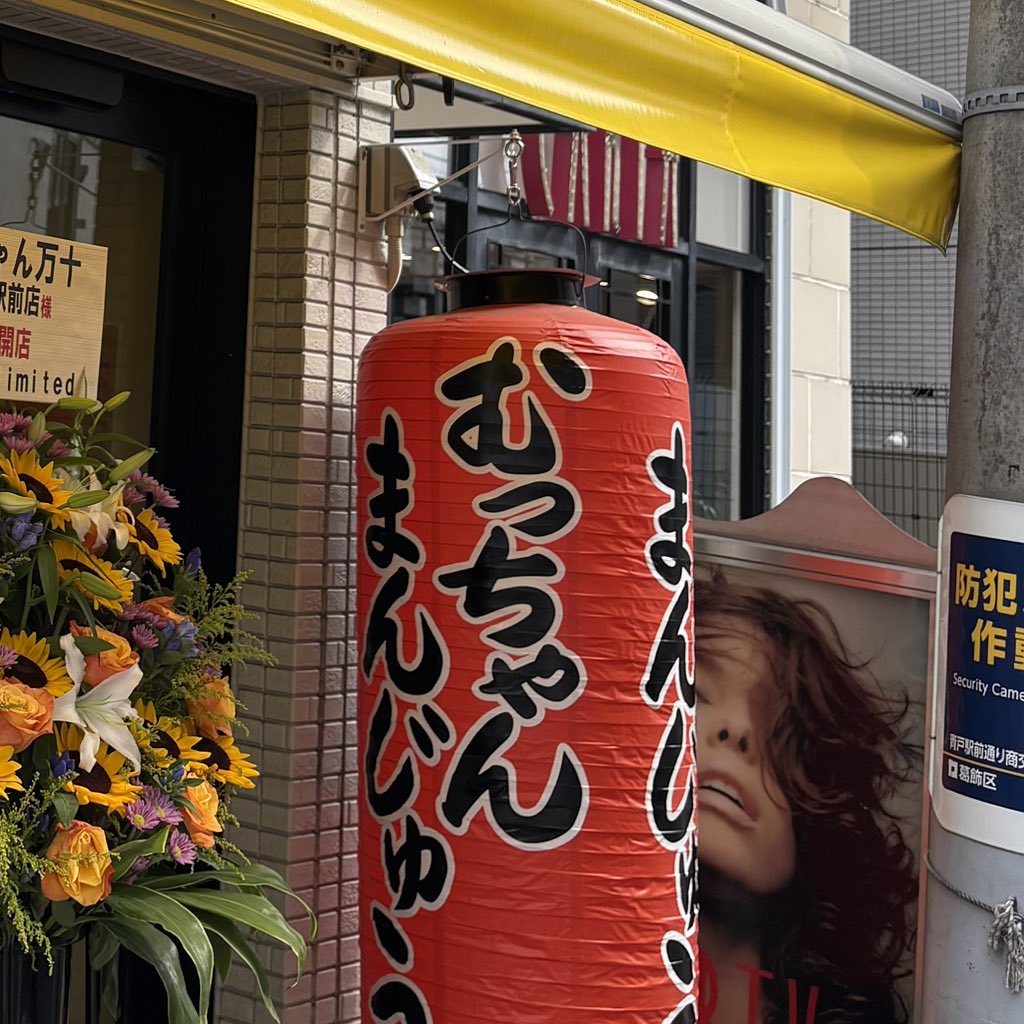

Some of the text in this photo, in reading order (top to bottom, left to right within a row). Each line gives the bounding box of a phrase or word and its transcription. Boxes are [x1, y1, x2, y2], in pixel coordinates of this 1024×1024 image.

[438, 338, 588, 846] むっちゃん
[954, 562, 1024, 616] 防犯
[953, 672, 988, 697] Security
[959, 764, 997, 791] 葛飾区
